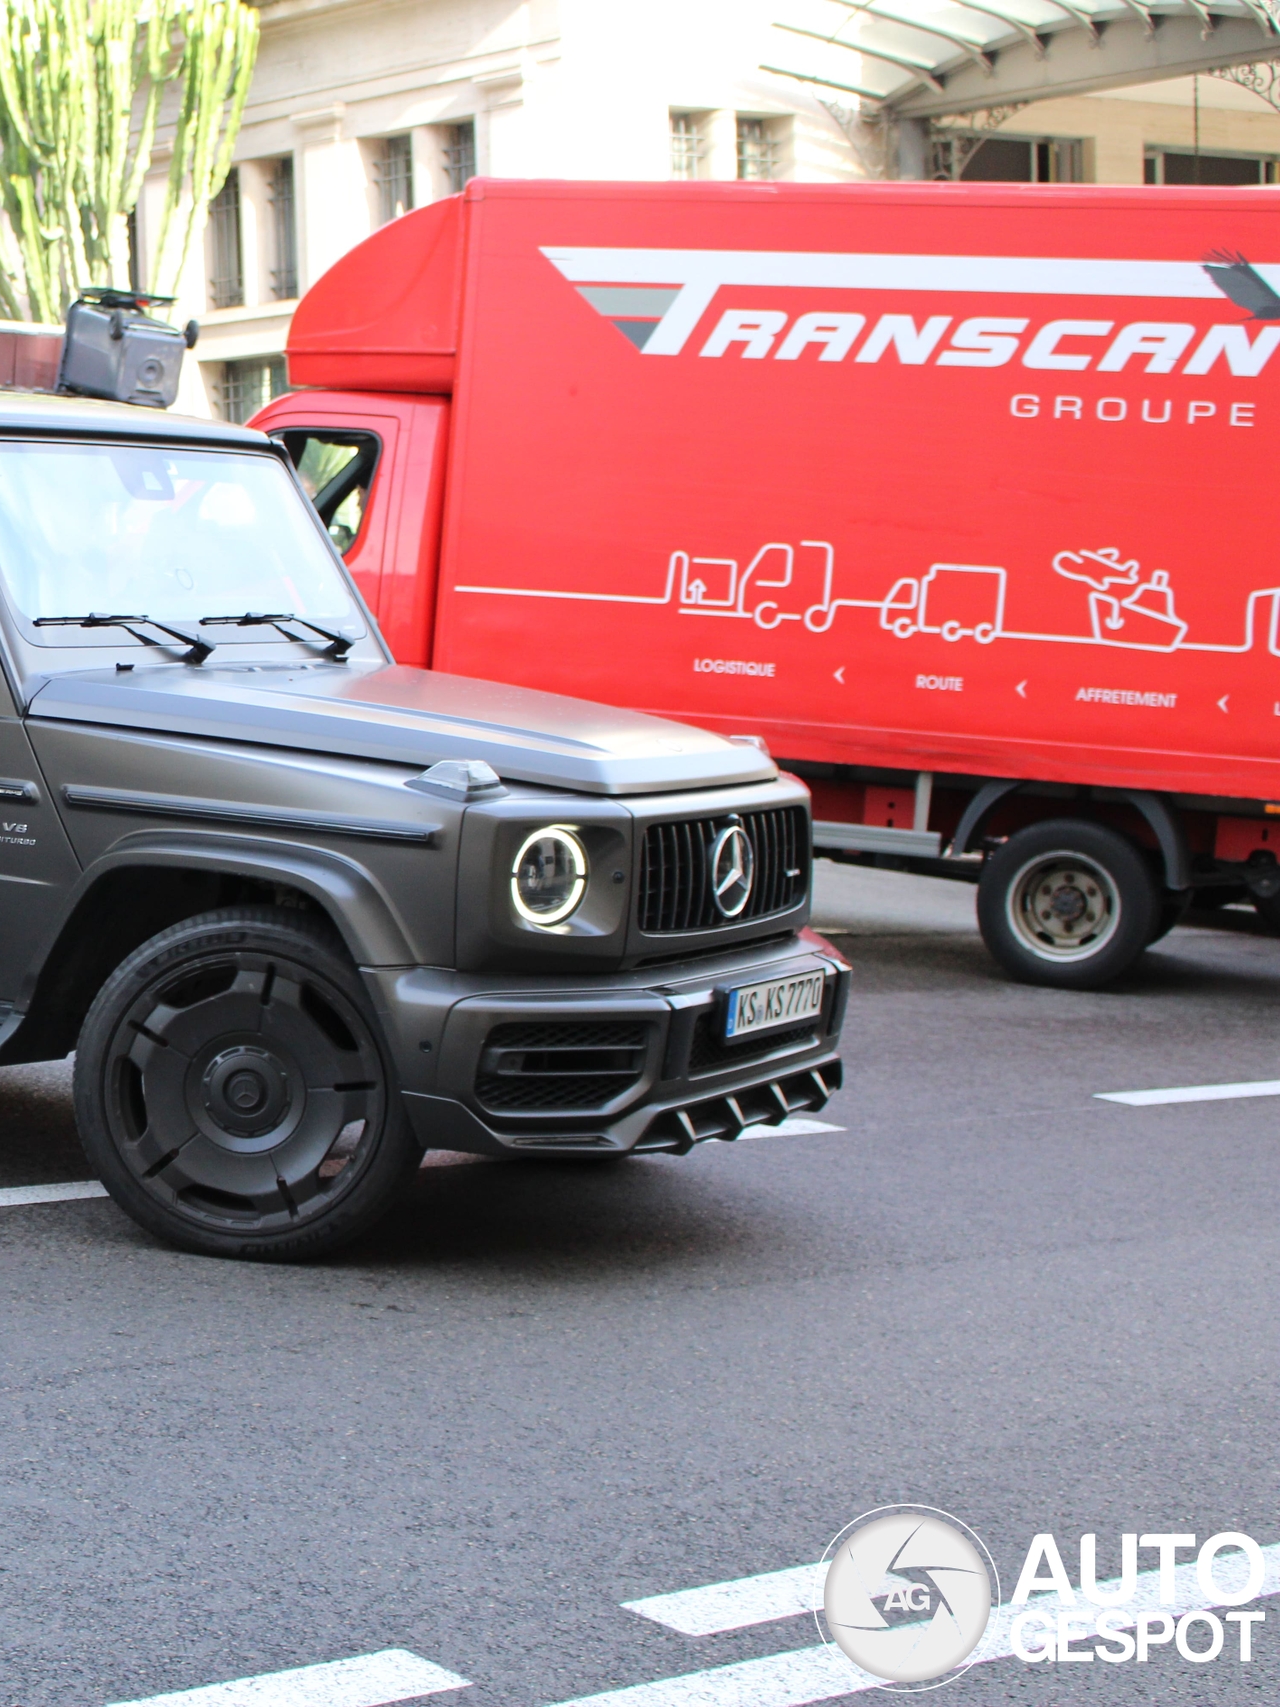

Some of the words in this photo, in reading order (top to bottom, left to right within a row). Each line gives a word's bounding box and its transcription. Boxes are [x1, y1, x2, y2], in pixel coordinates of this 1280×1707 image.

[540, 246, 1280, 377] TRANSCAN
[1009, 393, 1257, 427] GROUPE
[693, 658, 776, 677] LOGISTIQUE
[915, 674, 964, 691] ROUTE
[1075, 686, 1178, 708] AFFRETEMENT
[2, 822, 28, 834] V8
